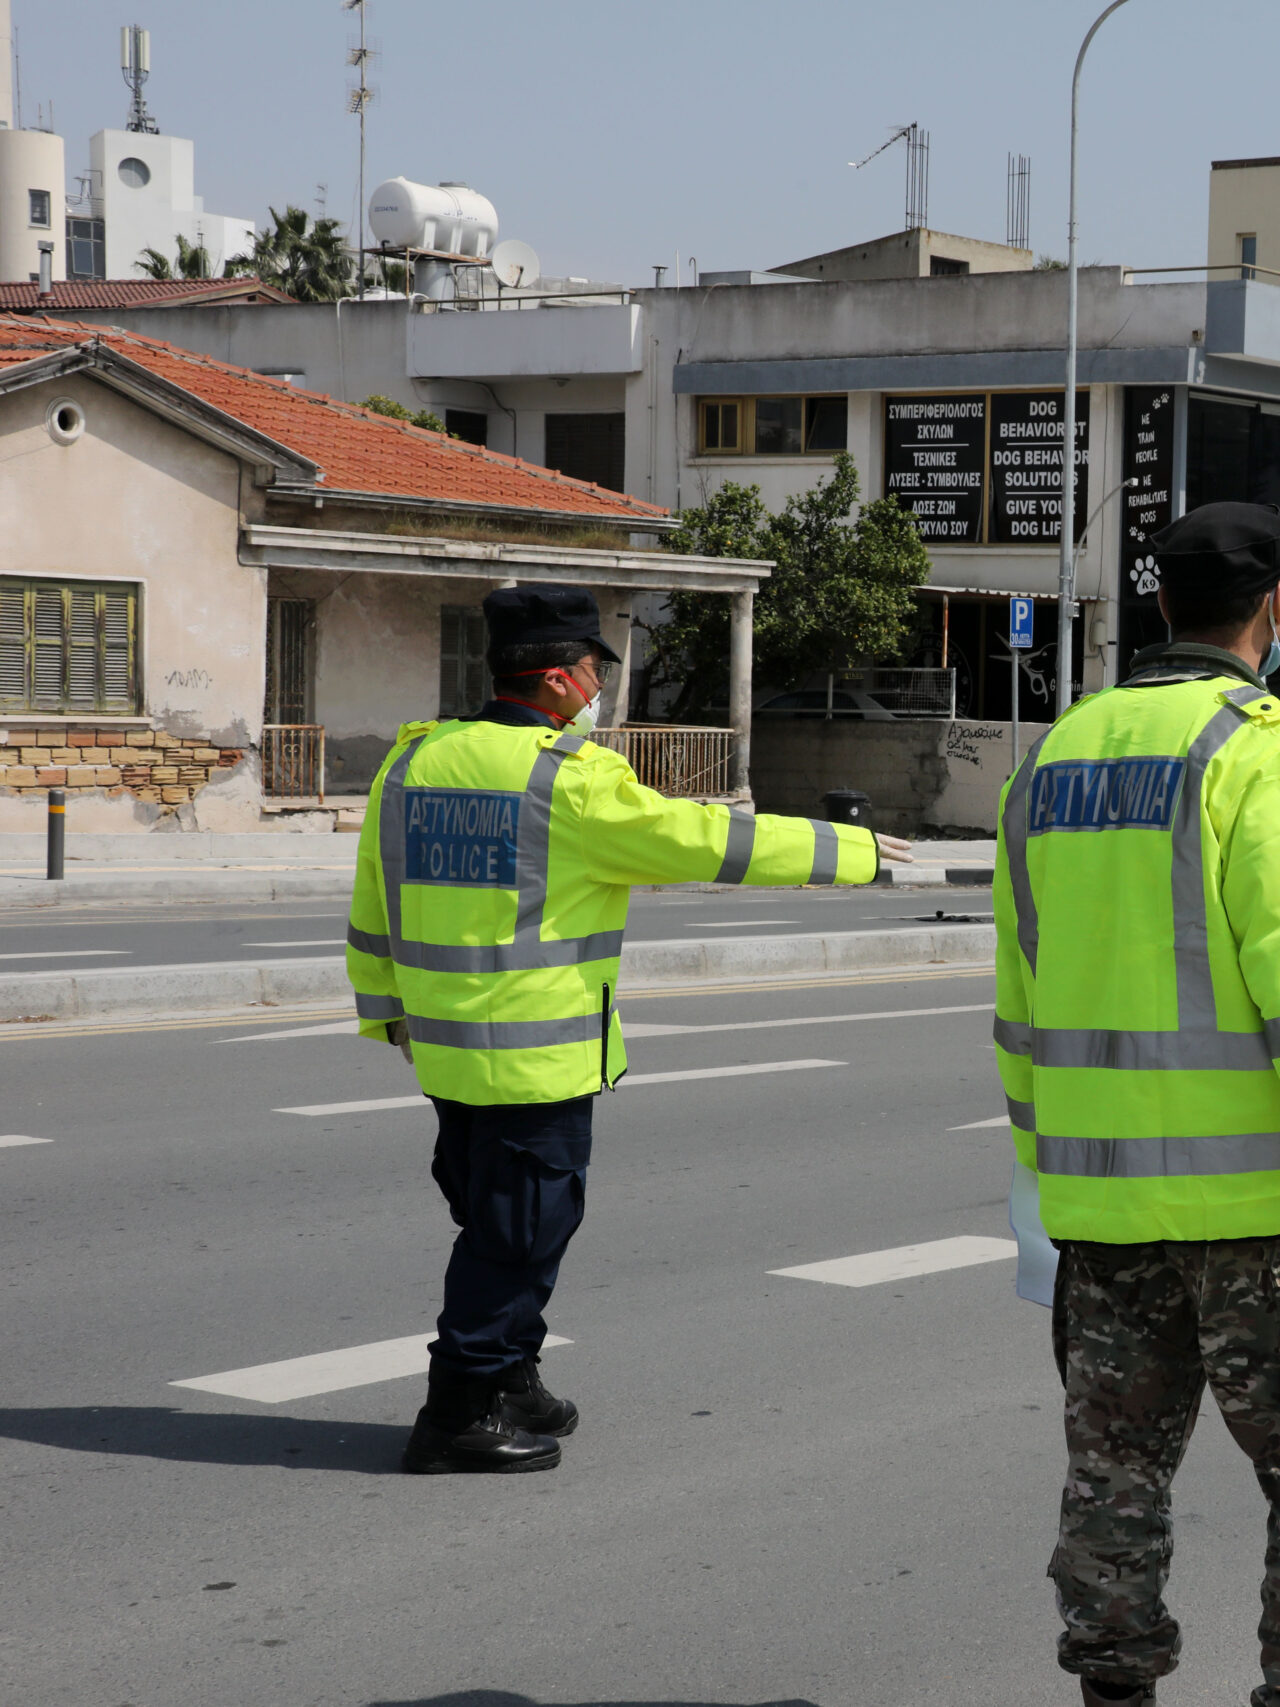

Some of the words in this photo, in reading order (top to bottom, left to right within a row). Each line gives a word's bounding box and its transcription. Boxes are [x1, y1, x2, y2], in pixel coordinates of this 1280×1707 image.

[888, 403, 984, 419] ΣΥΜΠΕΡΙΦΕΡΙΟΛΟΓΟΣ
[1029, 401, 1057, 416] DOG
[1141, 413, 1150, 425] WE
[917, 424, 954, 439] ΣΚΥΛΩΝ
[999, 421, 1087, 438] BEHAVIORT
[1137, 430, 1155, 445] TRAIN
[912, 451, 957, 467] ΤΕΧΝΙΚΕΣ
[993, 450, 1021, 466] DOG
[1024, 449, 1090, 465] BEHAVOR
[1135, 448, 1158, 464] PEOPLE
[888, 472, 920, 487] ΛΥΣΕΙΣ
[927, 472, 981, 487] ΣΥΜΒΟΥΛΕΣ
[1005, 471, 1079, 487] SOLUTIOS
[1142, 474, 1152, 487] WE
[1128, 489, 1168, 508] REHABILITATE
[911, 500, 935, 515] ΔΩΣΕ
[936, 500, 956, 515] ΖΩΗ
[1006, 500, 1037, 515] GIVE
[1140, 510, 1156, 524] DOGS
[950, 521, 969, 536] ΣΟΥ
[1011, 521, 1039, 536] DOG
[1042, 521, 1062, 536] LIF
[1142, 580, 1156, 590] K9
[1015, 601, 1028, 631] P
[1011, 633, 1018, 645] 30
[408, 796, 514, 839] ΑΣΤΥΝΟΜΙΑ
